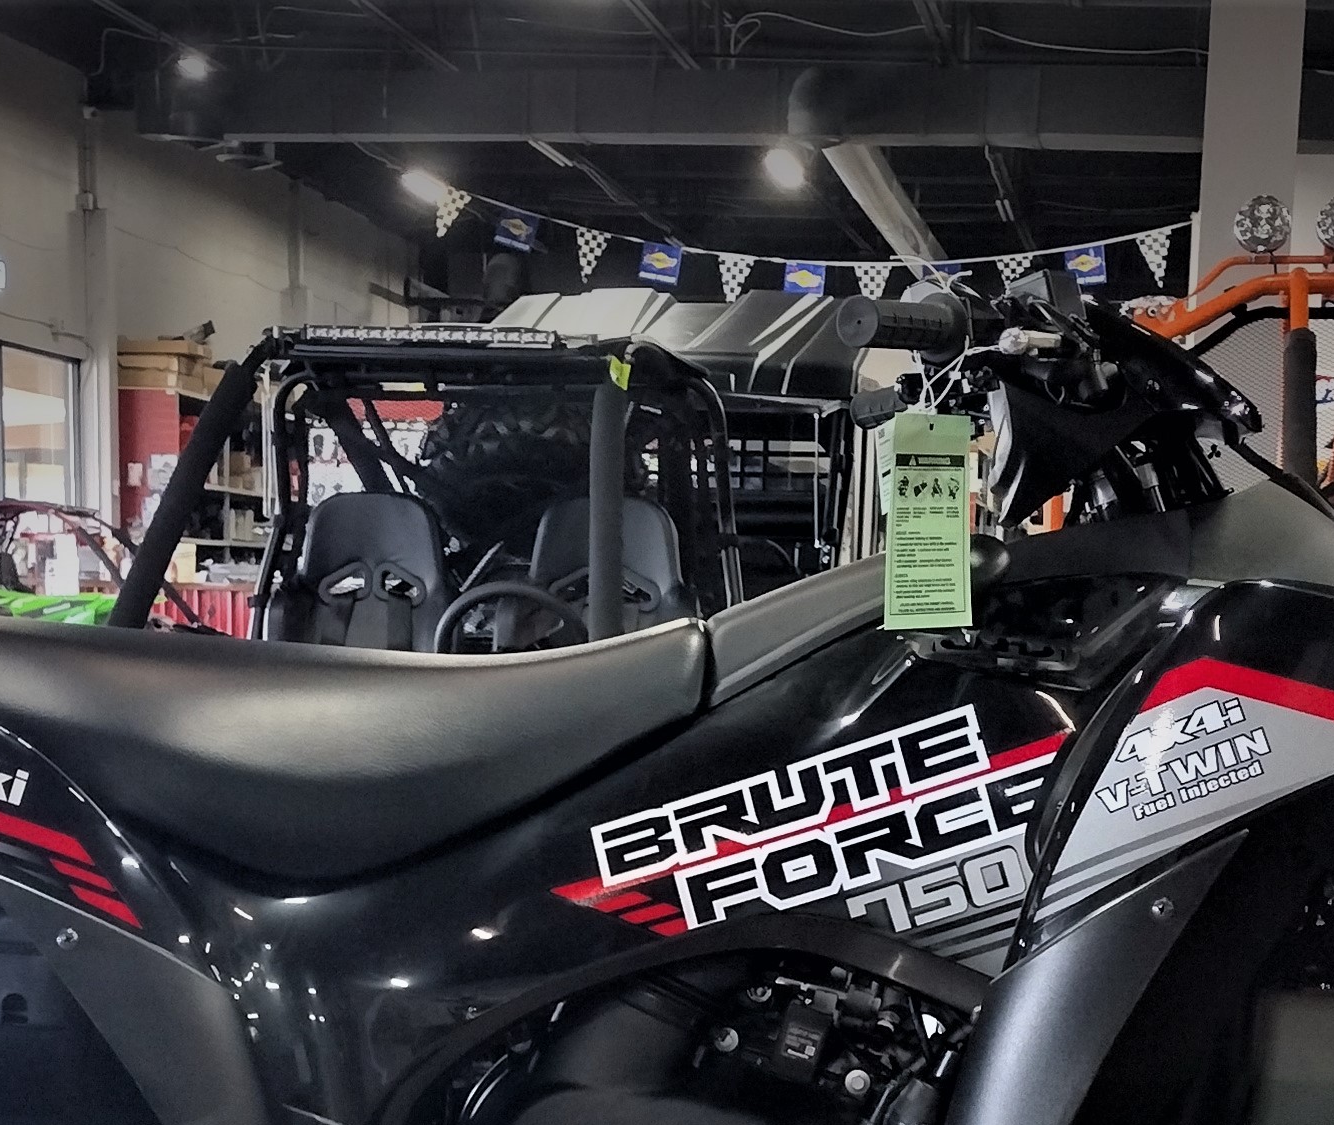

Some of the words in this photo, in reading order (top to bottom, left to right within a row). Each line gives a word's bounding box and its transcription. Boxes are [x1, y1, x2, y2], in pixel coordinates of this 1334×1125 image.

[589, 704, 992, 885] BRUTE
[1095, 726, 1272, 814] V-TWIN
[1132, 790, 1177, 821] Fuel
[1179, 760, 1265, 805] Injected
[676, 752, 1057, 929] FORCE
[845, 846, 1027, 933] 750
